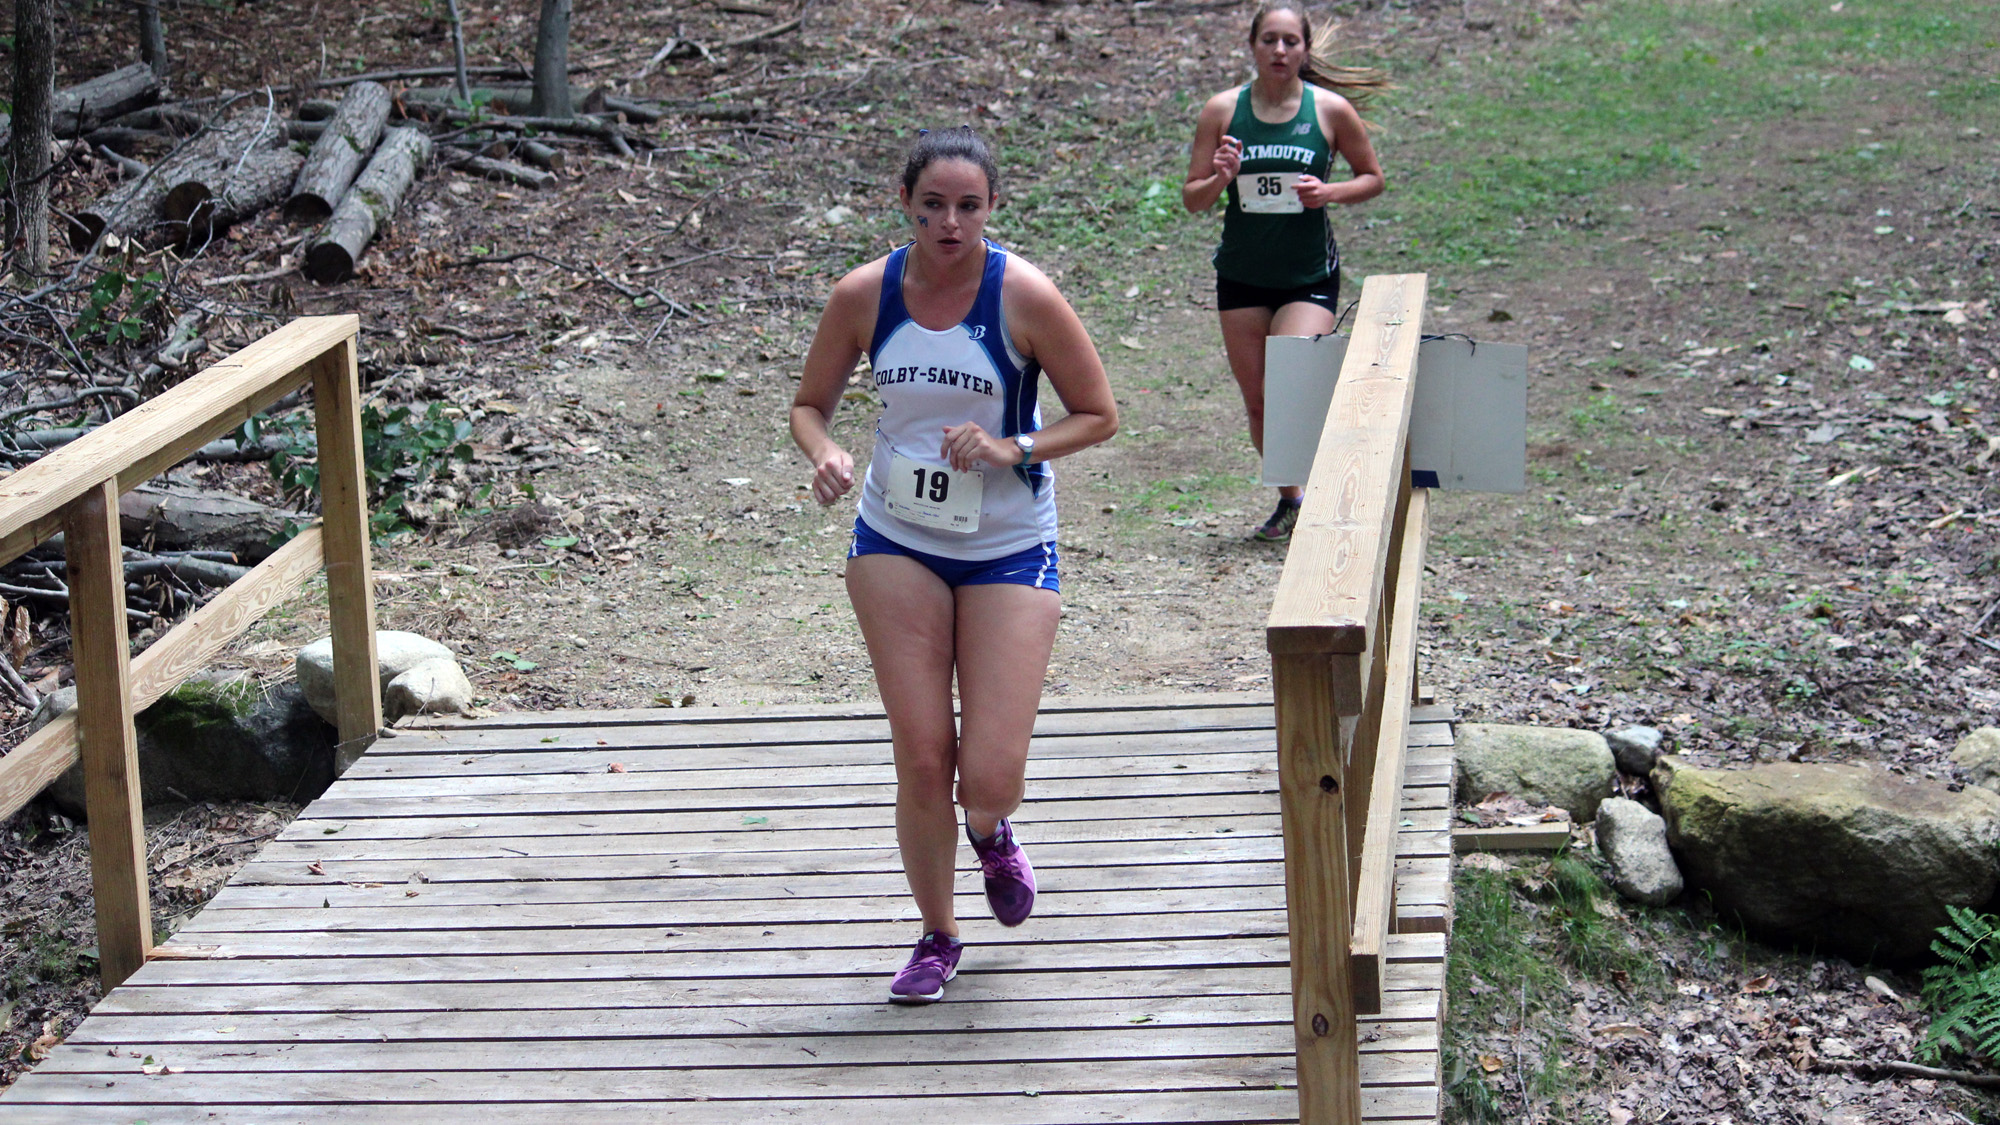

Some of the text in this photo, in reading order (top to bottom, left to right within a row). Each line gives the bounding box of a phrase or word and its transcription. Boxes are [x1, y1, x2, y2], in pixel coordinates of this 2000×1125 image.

[1239, 144, 1316, 166] LYMOUTH
[1257, 176, 1282, 196] 35
[875, 366, 994, 396] COLBY-SAWYER
[913, 467, 950, 503] 19
